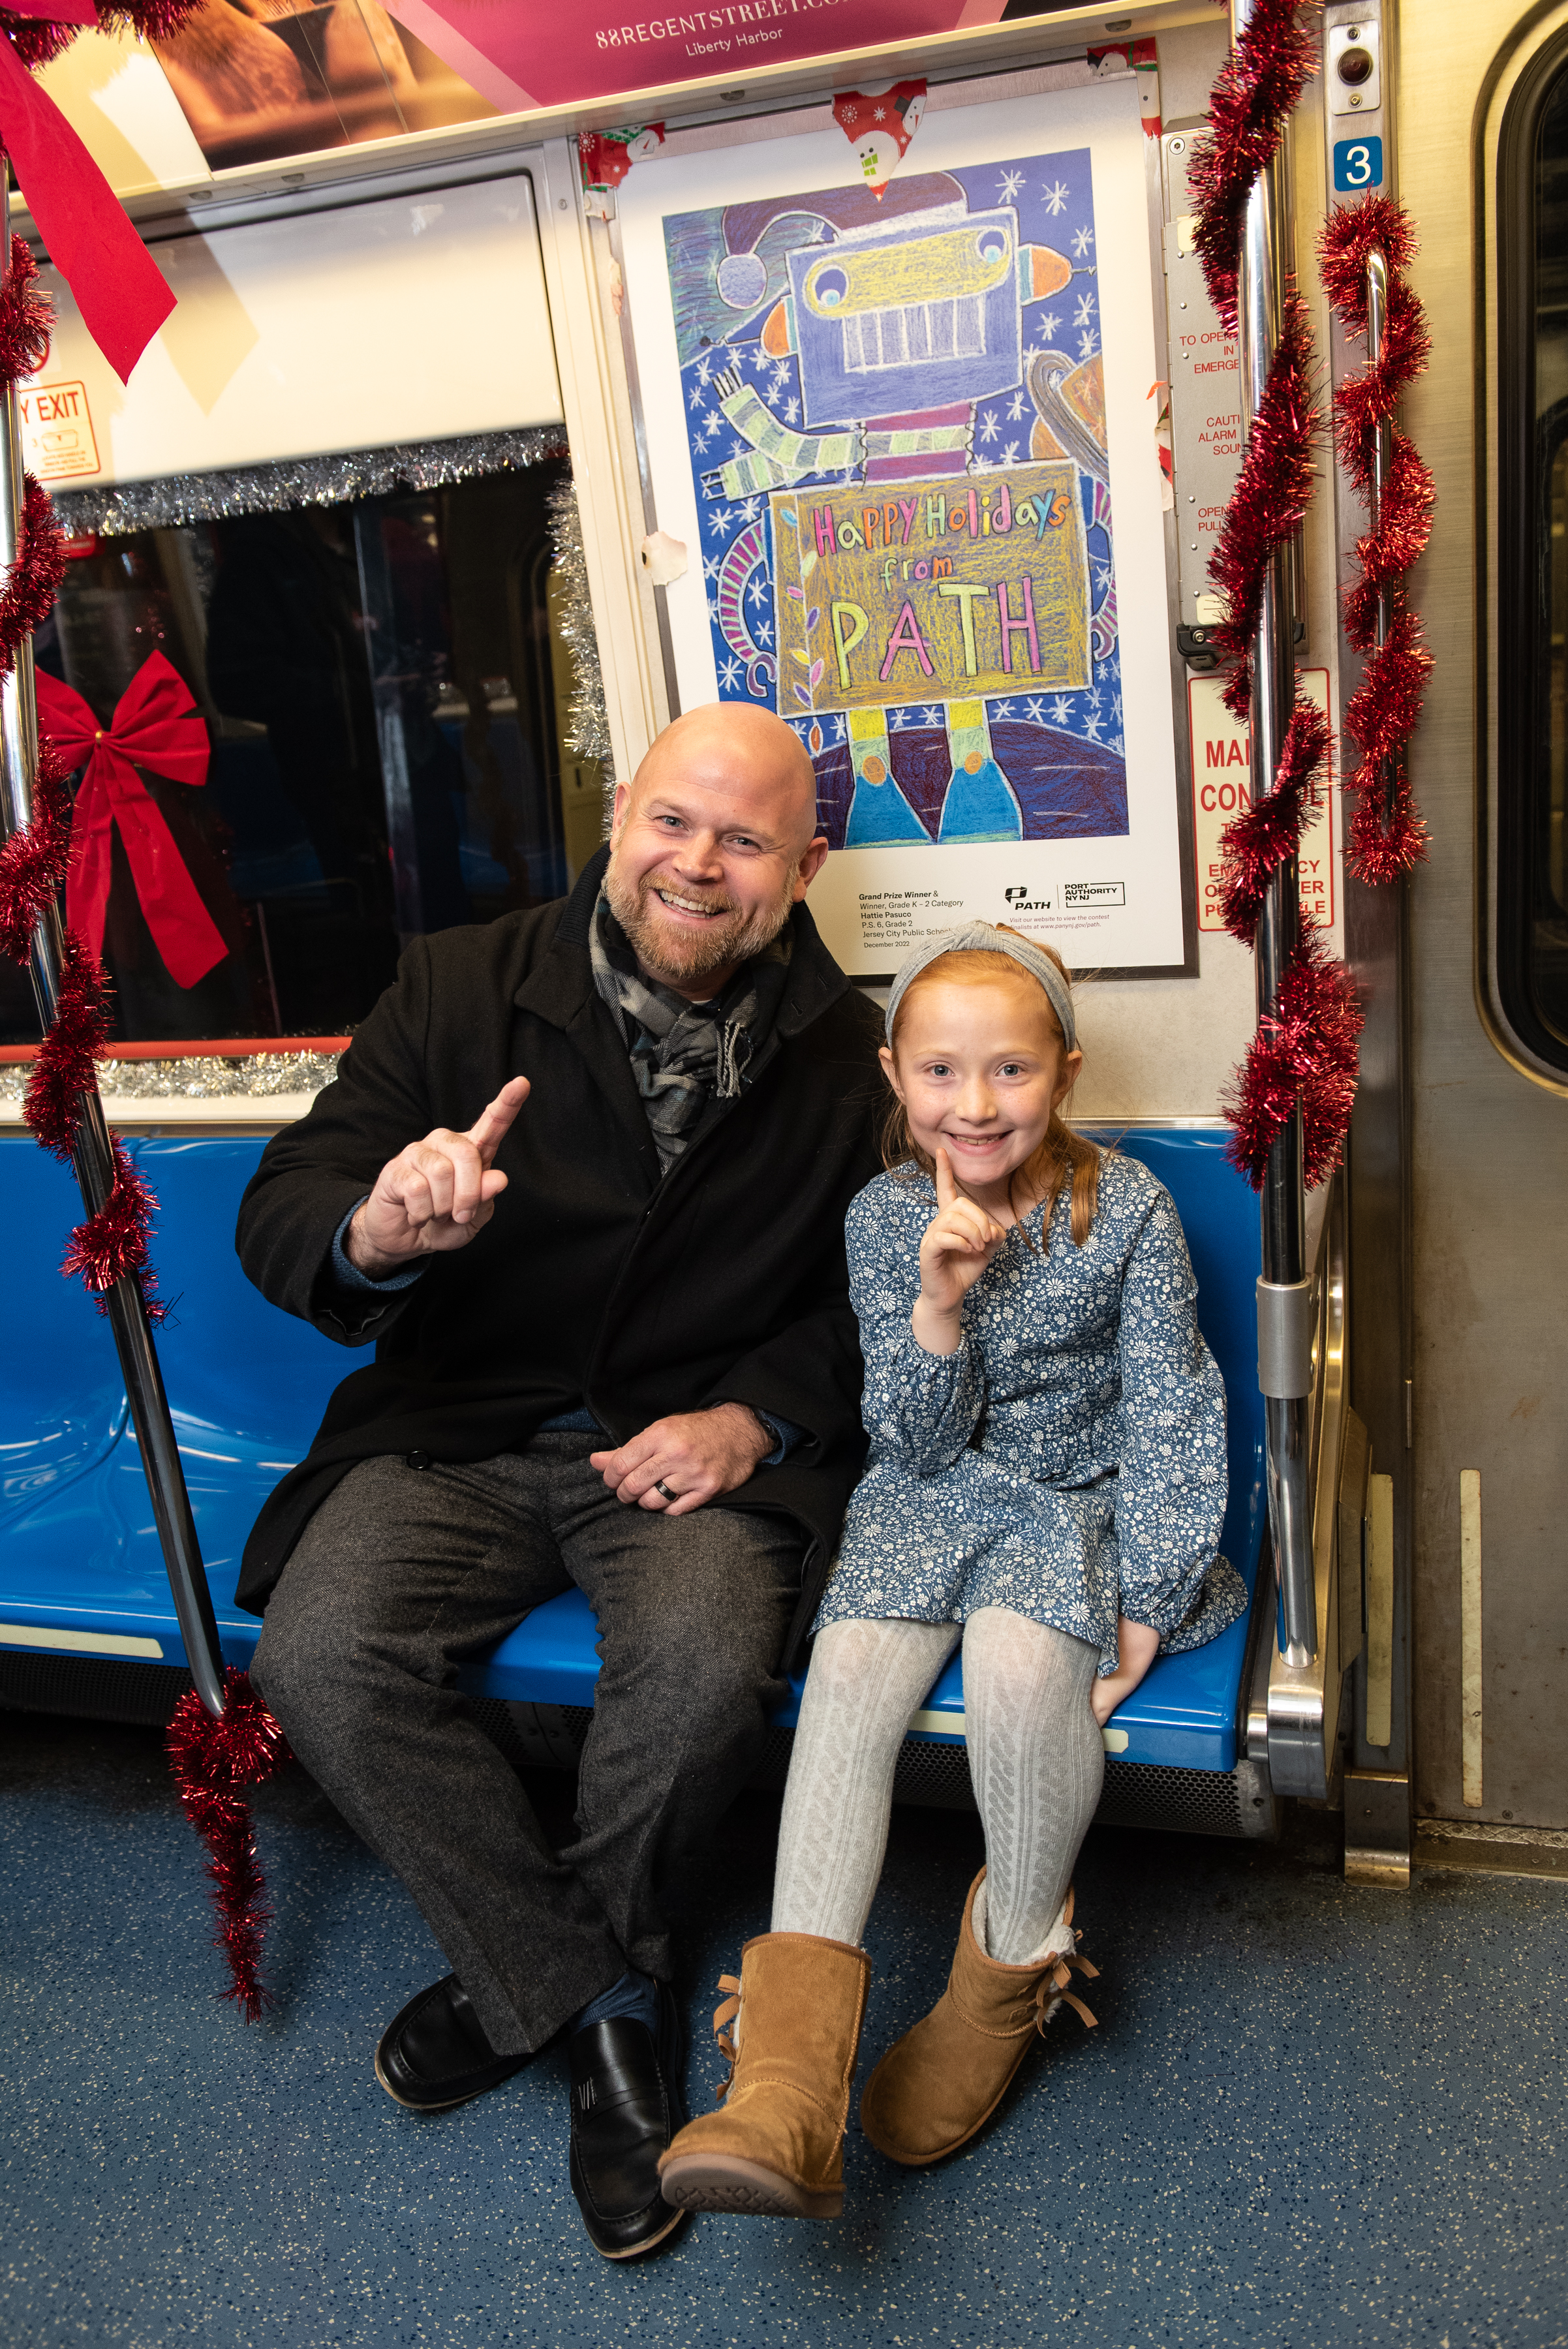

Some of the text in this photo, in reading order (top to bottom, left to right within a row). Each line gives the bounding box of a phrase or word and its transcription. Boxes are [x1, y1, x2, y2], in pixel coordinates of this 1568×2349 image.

[596, 0, 848, 49] 88REGENTSTREET.
[686, 29, 783, 56] Liberty Harbor
[1346, 146, 1372, 184] 3
[1179, 335, 1196, 346] TO
[1223, 345, 1234, 356] IN
[1194, 359, 1239, 374] EMERGE
[37, 391, 78, 421] EXIT
[1207, 414, 1240, 427] CAUTI
[1198, 429, 1237, 442] ALARM
[926, 484, 1071, 541] Holidays
[879, 556, 953, 592] from
[831, 576, 1042, 690] PATH
[931, 900, 964, 908] Category
[1015, 901, 1051, 910] PATH
[1040, 921, 1101, 930] www.panynj.gov/path.
